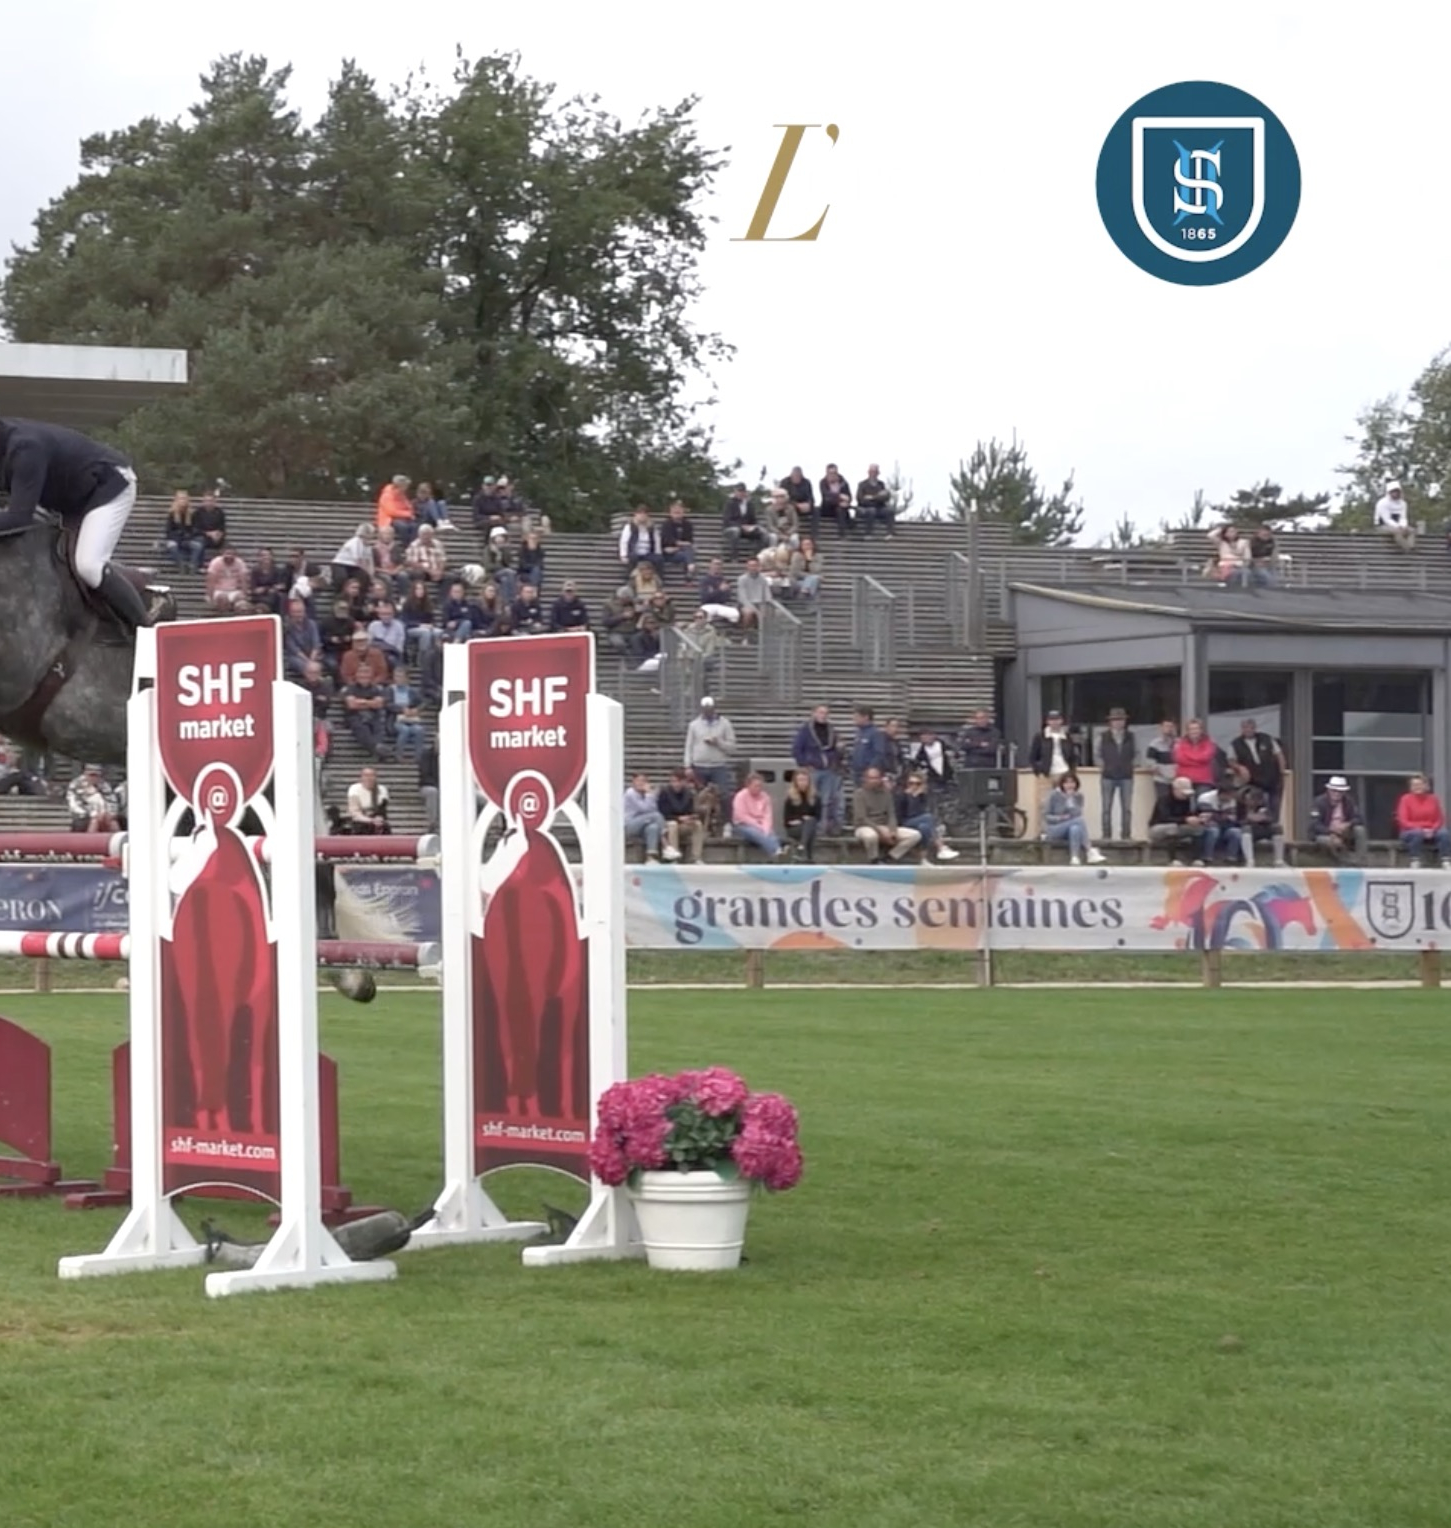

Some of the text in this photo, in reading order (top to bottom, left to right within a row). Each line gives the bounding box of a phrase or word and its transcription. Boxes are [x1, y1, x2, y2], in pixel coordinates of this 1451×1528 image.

[177, 662, 255, 706] SHF
[489, 676, 568, 717] SHF
[179, 714, 255, 739] market
[490, 725, 567, 748] market
[673, 880, 1124, 945] grandes semaines
[482, 1121, 586, 1143] shf-market.com
[171, 1136, 276, 1160] shf-market.com
